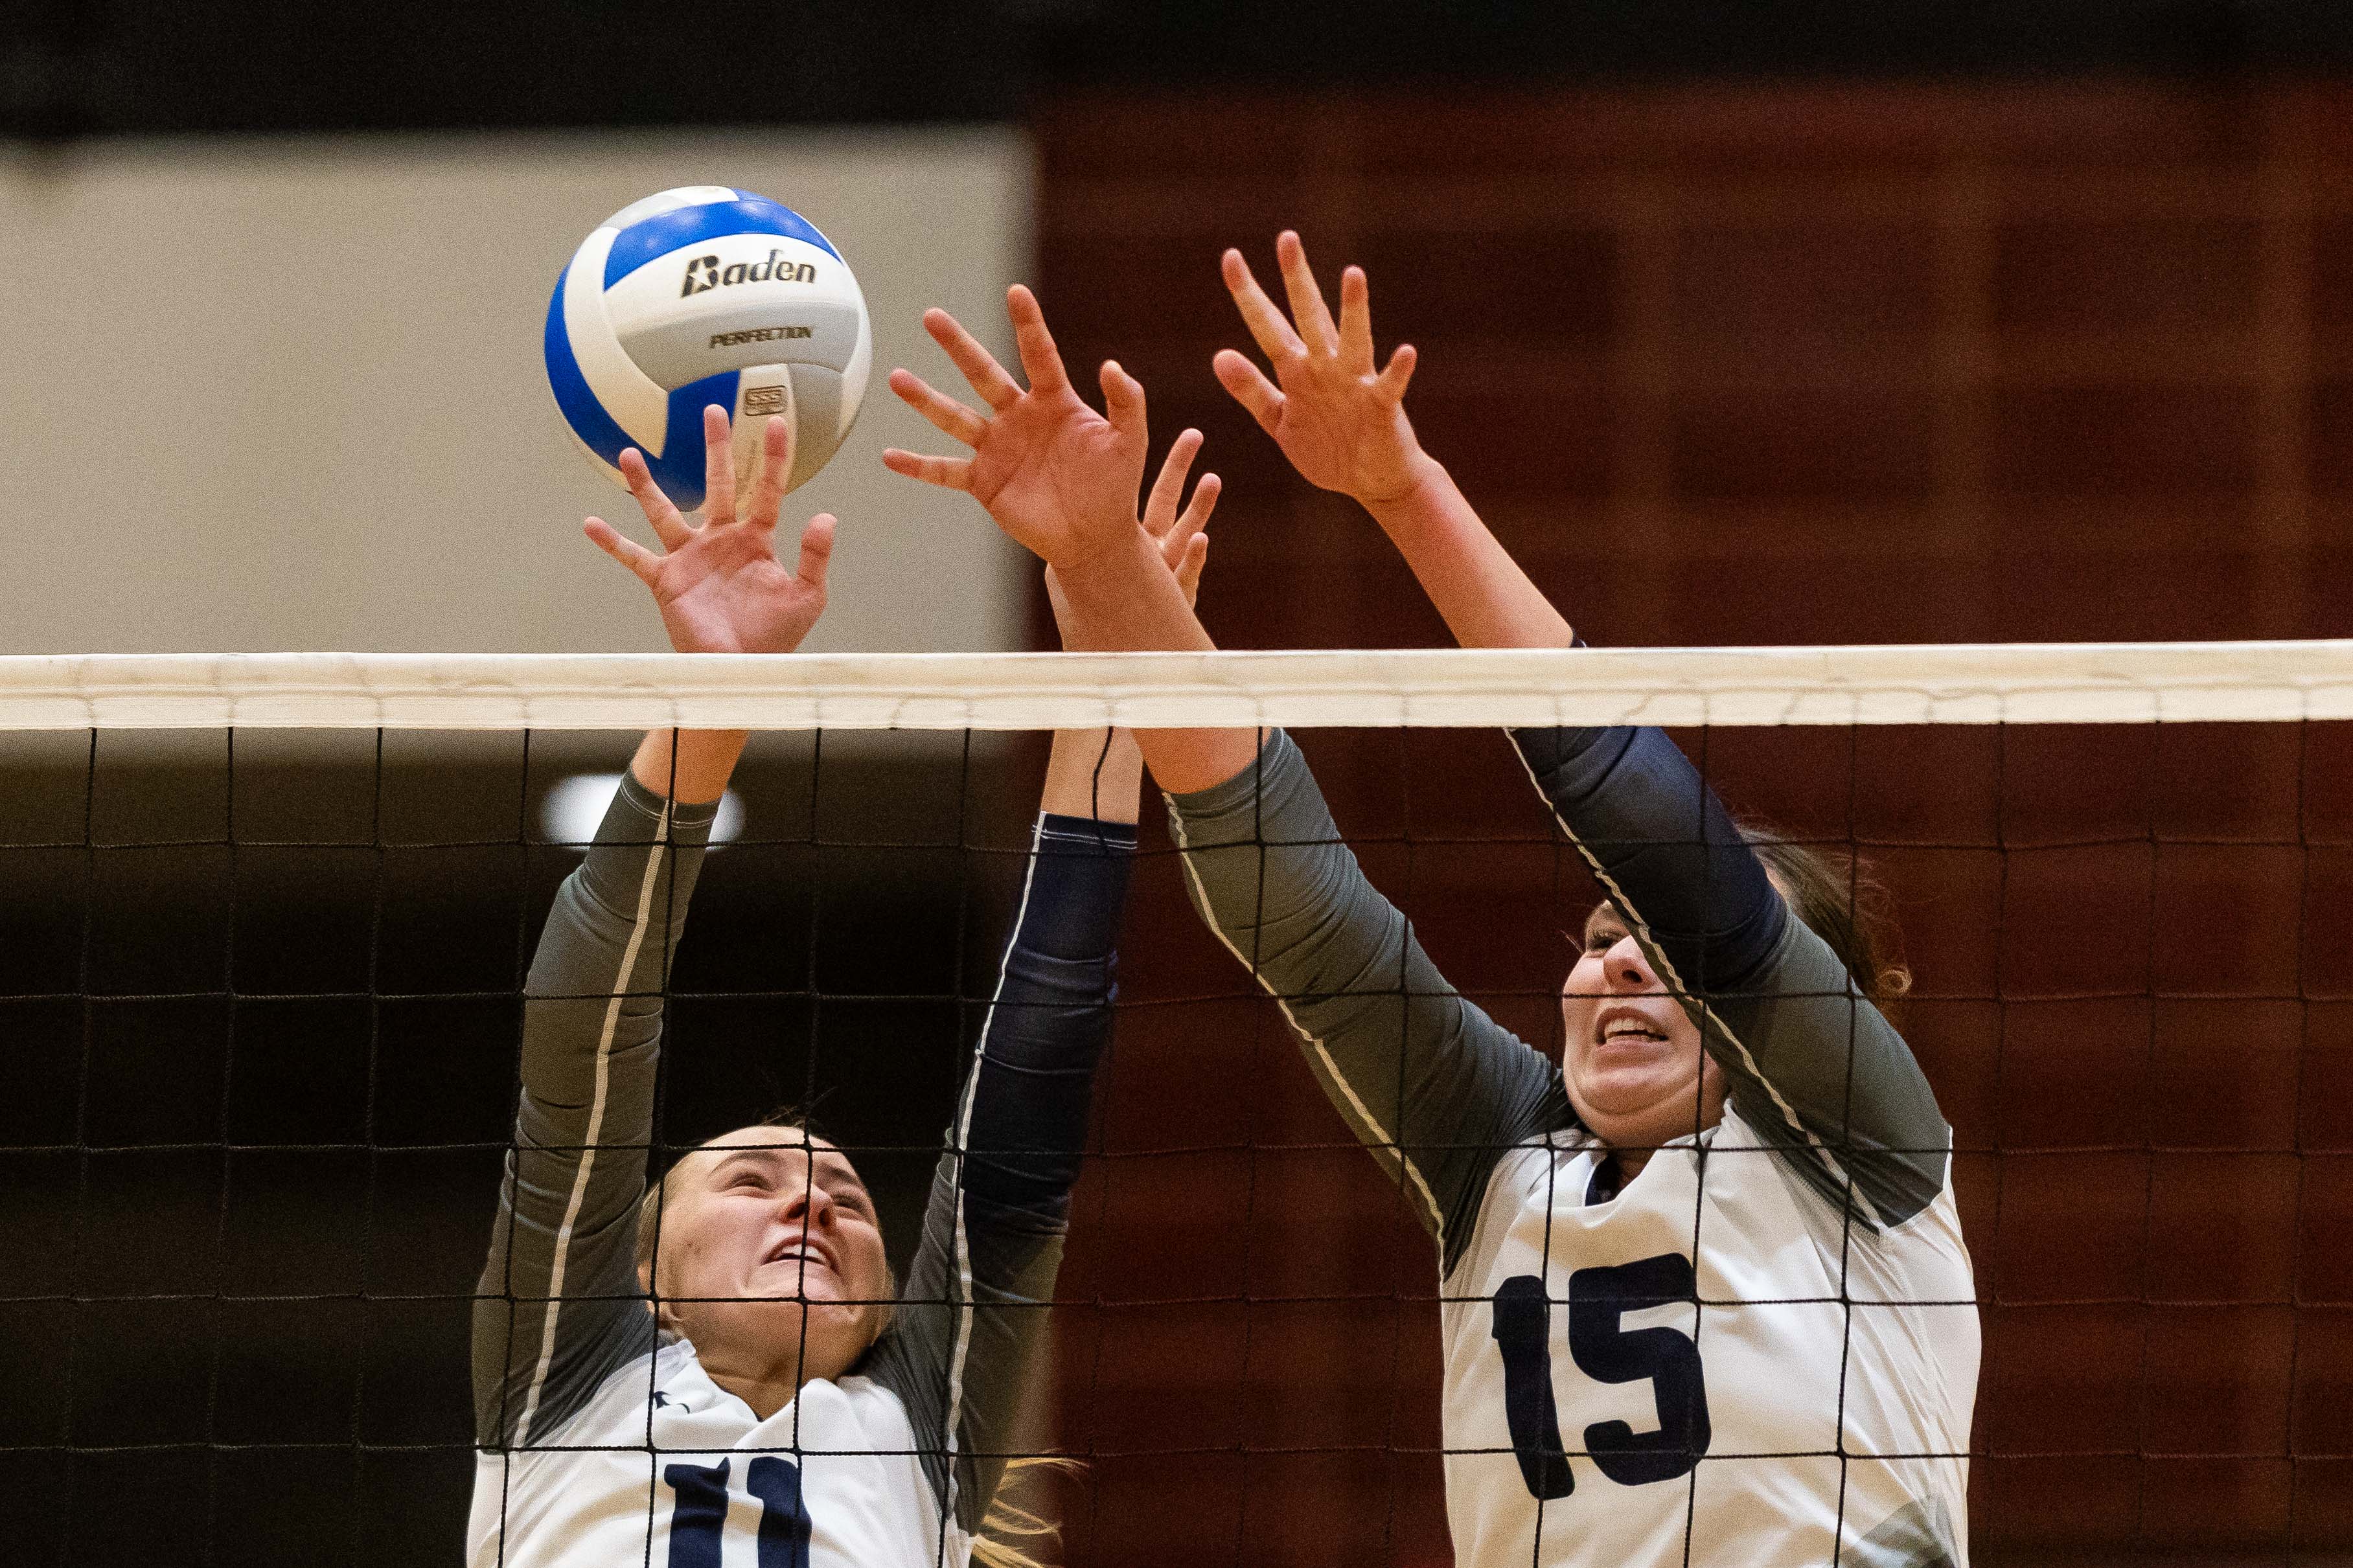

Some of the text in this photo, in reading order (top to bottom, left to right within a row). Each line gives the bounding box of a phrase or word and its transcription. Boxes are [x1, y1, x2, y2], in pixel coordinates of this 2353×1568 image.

[680, 249, 816, 298] Baden
[709, 326, 812, 349] PERFECTION
[1491, 1252, 1712, 1501] 15
